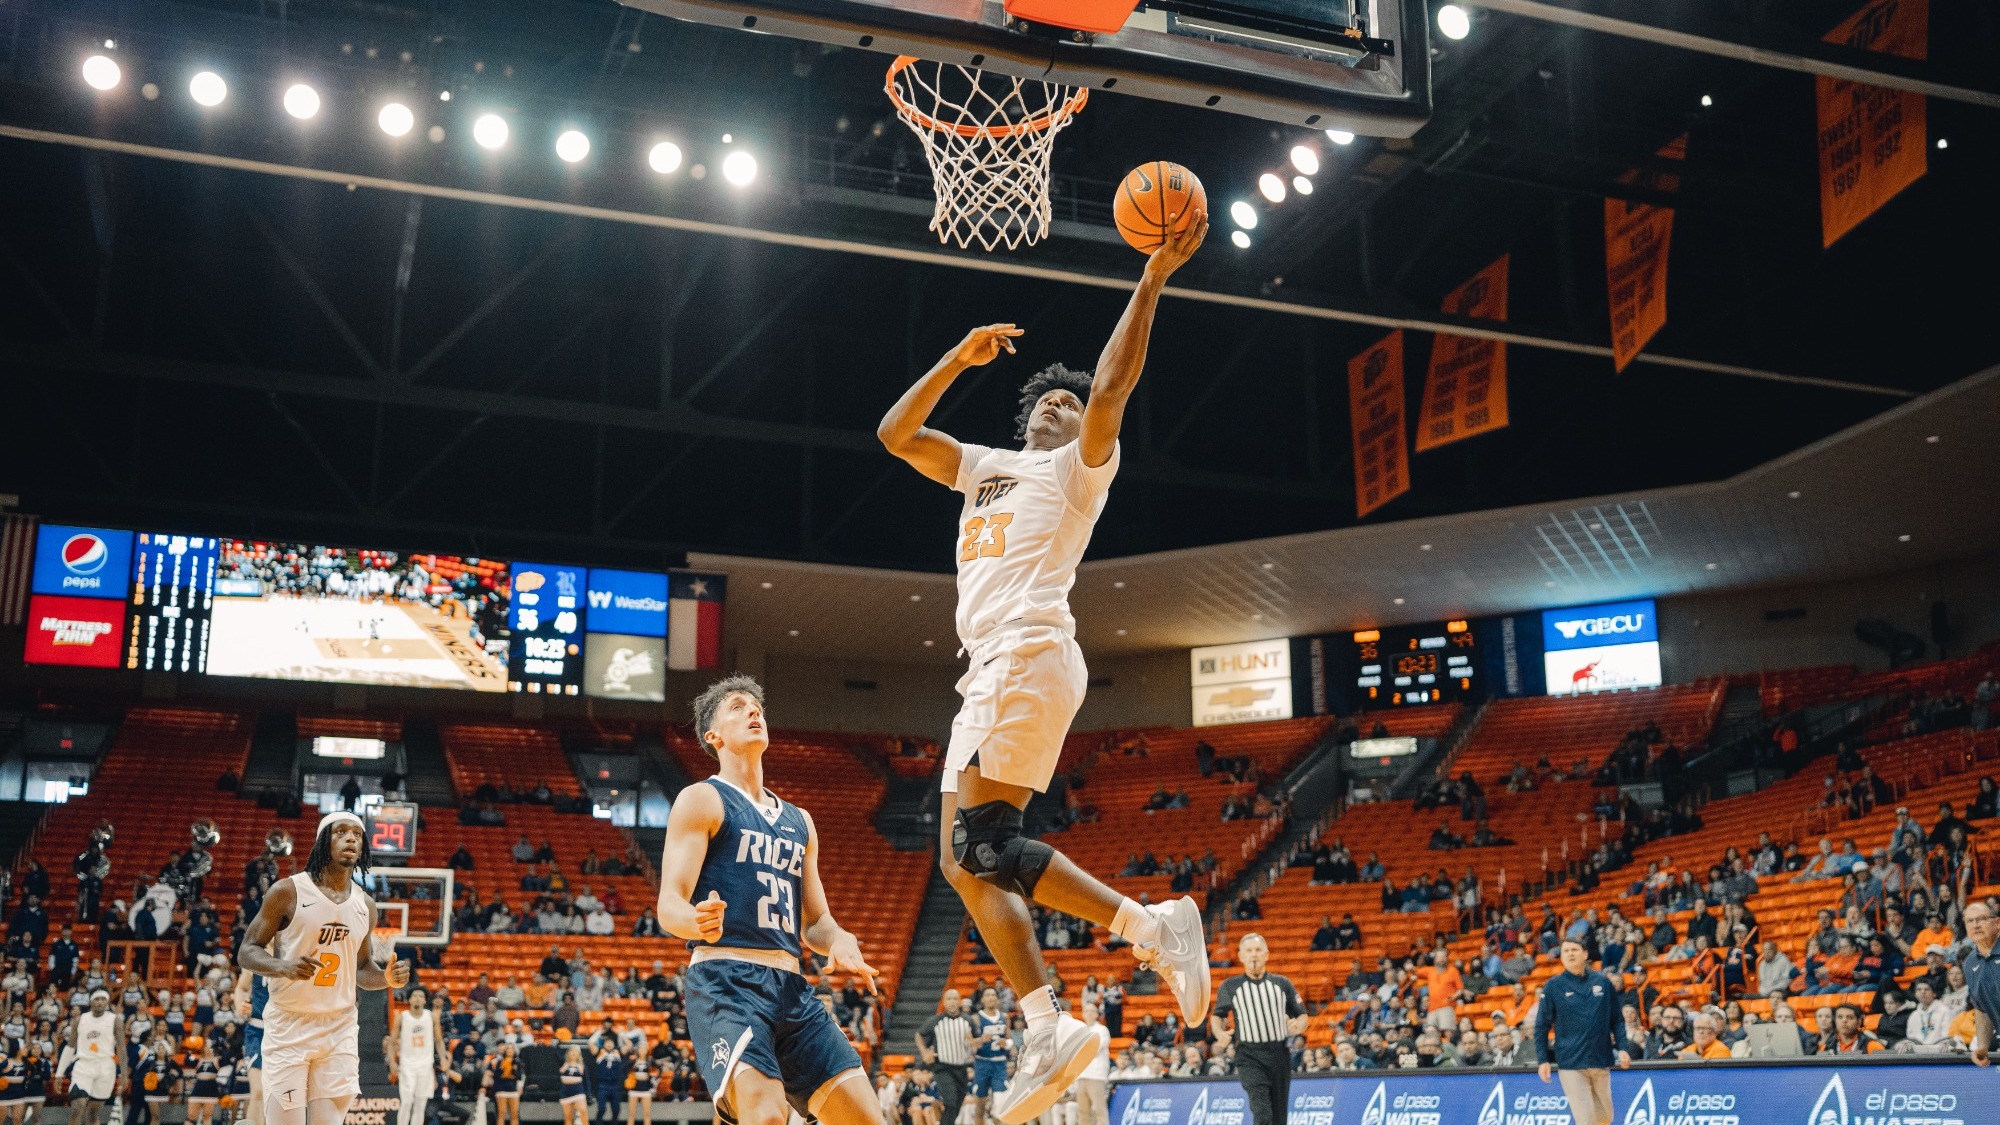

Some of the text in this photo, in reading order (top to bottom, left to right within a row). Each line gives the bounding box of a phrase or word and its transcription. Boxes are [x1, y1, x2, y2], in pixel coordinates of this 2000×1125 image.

[975, 474, 1018, 508] UTEP
[960, 512, 1014, 562] 23
[63, 576, 101, 589] pepsi
[614, 595, 667, 612] WestStar
[40, 617, 113, 635] MATTRESS
[1580, 613, 1646, 637] GECU
[53, 629, 97, 645] FIRM
[1220, 650, 1282, 673] HUNT
[372, 822, 405, 849] 29
[736, 829, 806, 878] RICE
[757, 870, 795, 934] 23
[318, 922, 349, 946] UTEP
[313, 952, 341, 987] 2
[350, 1098, 400, 1111] EAKING
[1393, 1092, 1440, 1111] el paso
[1514, 1092, 1569, 1113] el paso
[1668, 1090, 1736, 1114] el paso
[1866, 1088, 1957, 1115] el paso
[345, 1112, 386, 1125] ROCK
[1287, 1111, 1335, 1125] WATER
[1386, 1112, 1441, 1125] WATER
[1506, 1114, 1571, 1125] WATER
